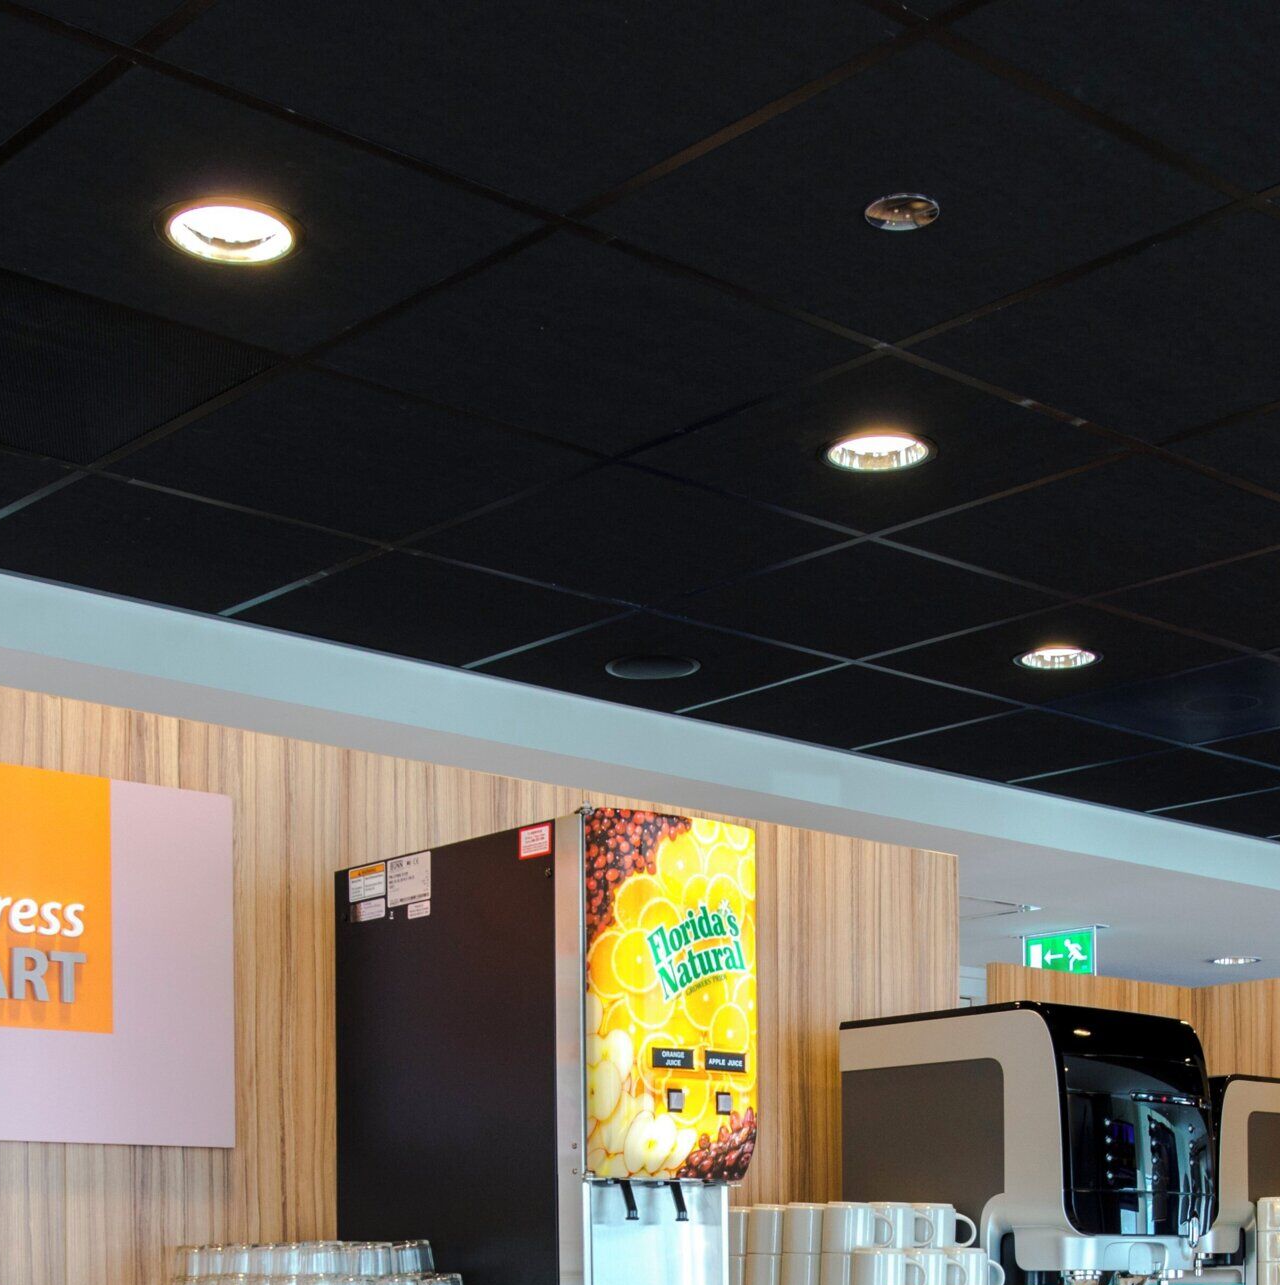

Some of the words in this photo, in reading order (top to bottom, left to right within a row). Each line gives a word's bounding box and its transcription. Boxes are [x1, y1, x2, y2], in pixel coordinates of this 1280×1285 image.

[647, 905, 740, 966] Florida's
[658, 940, 746, 1001] Natural
[661, 1050, 685, 1059] ORANGE
[665, 1059, 681, 1067] JUICE
[708, 1058, 726, 1067] APPLE
[727, 1059, 743, 1068] JUICE
